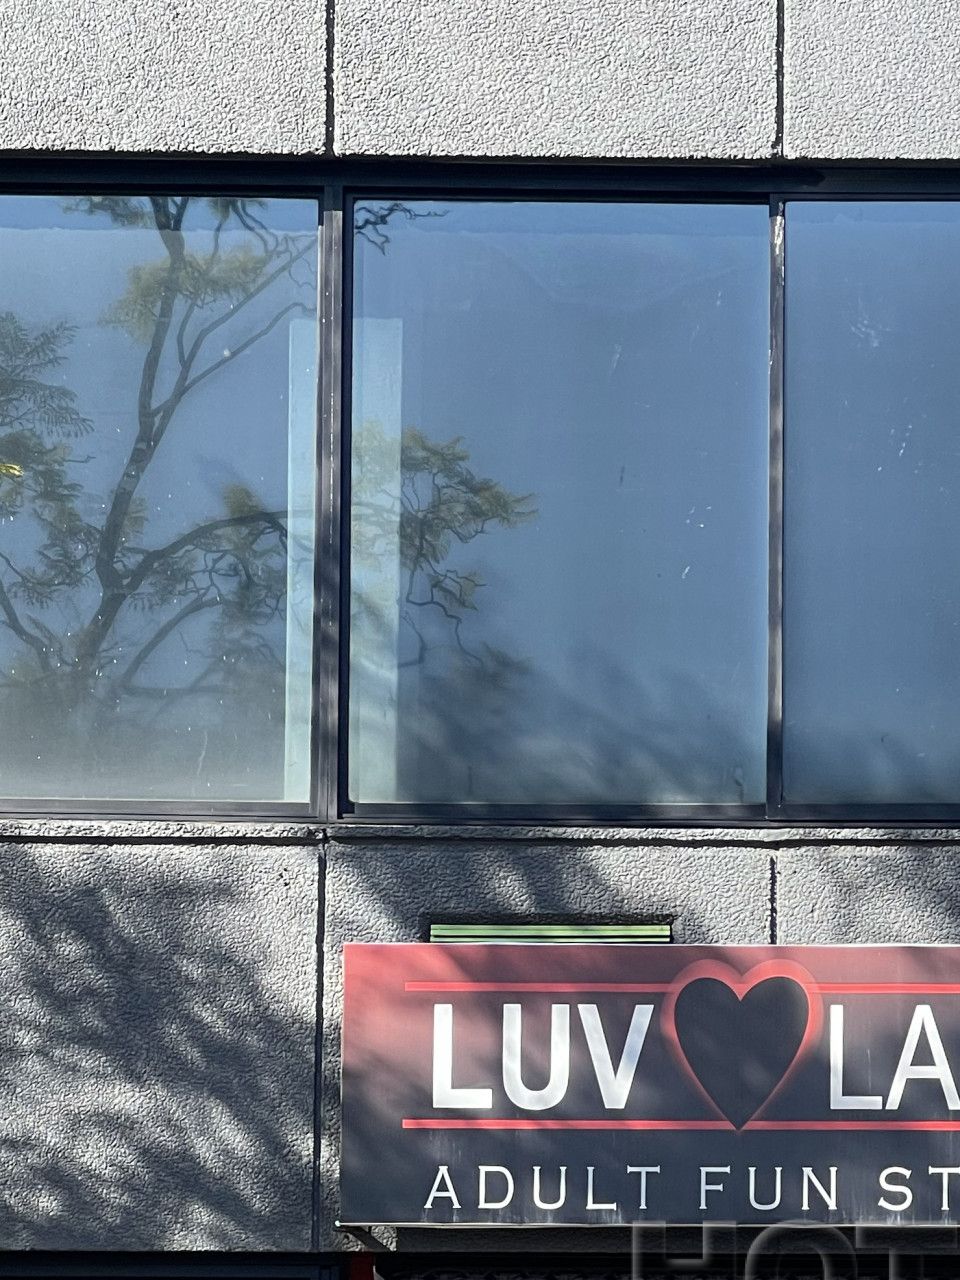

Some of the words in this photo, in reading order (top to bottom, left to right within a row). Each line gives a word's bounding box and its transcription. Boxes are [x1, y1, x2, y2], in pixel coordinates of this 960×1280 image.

[431, 1003, 655, 1111] LUV
[424, 1165, 661, 1210] ADULT
[699, 1166, 837, 1211] FUN
